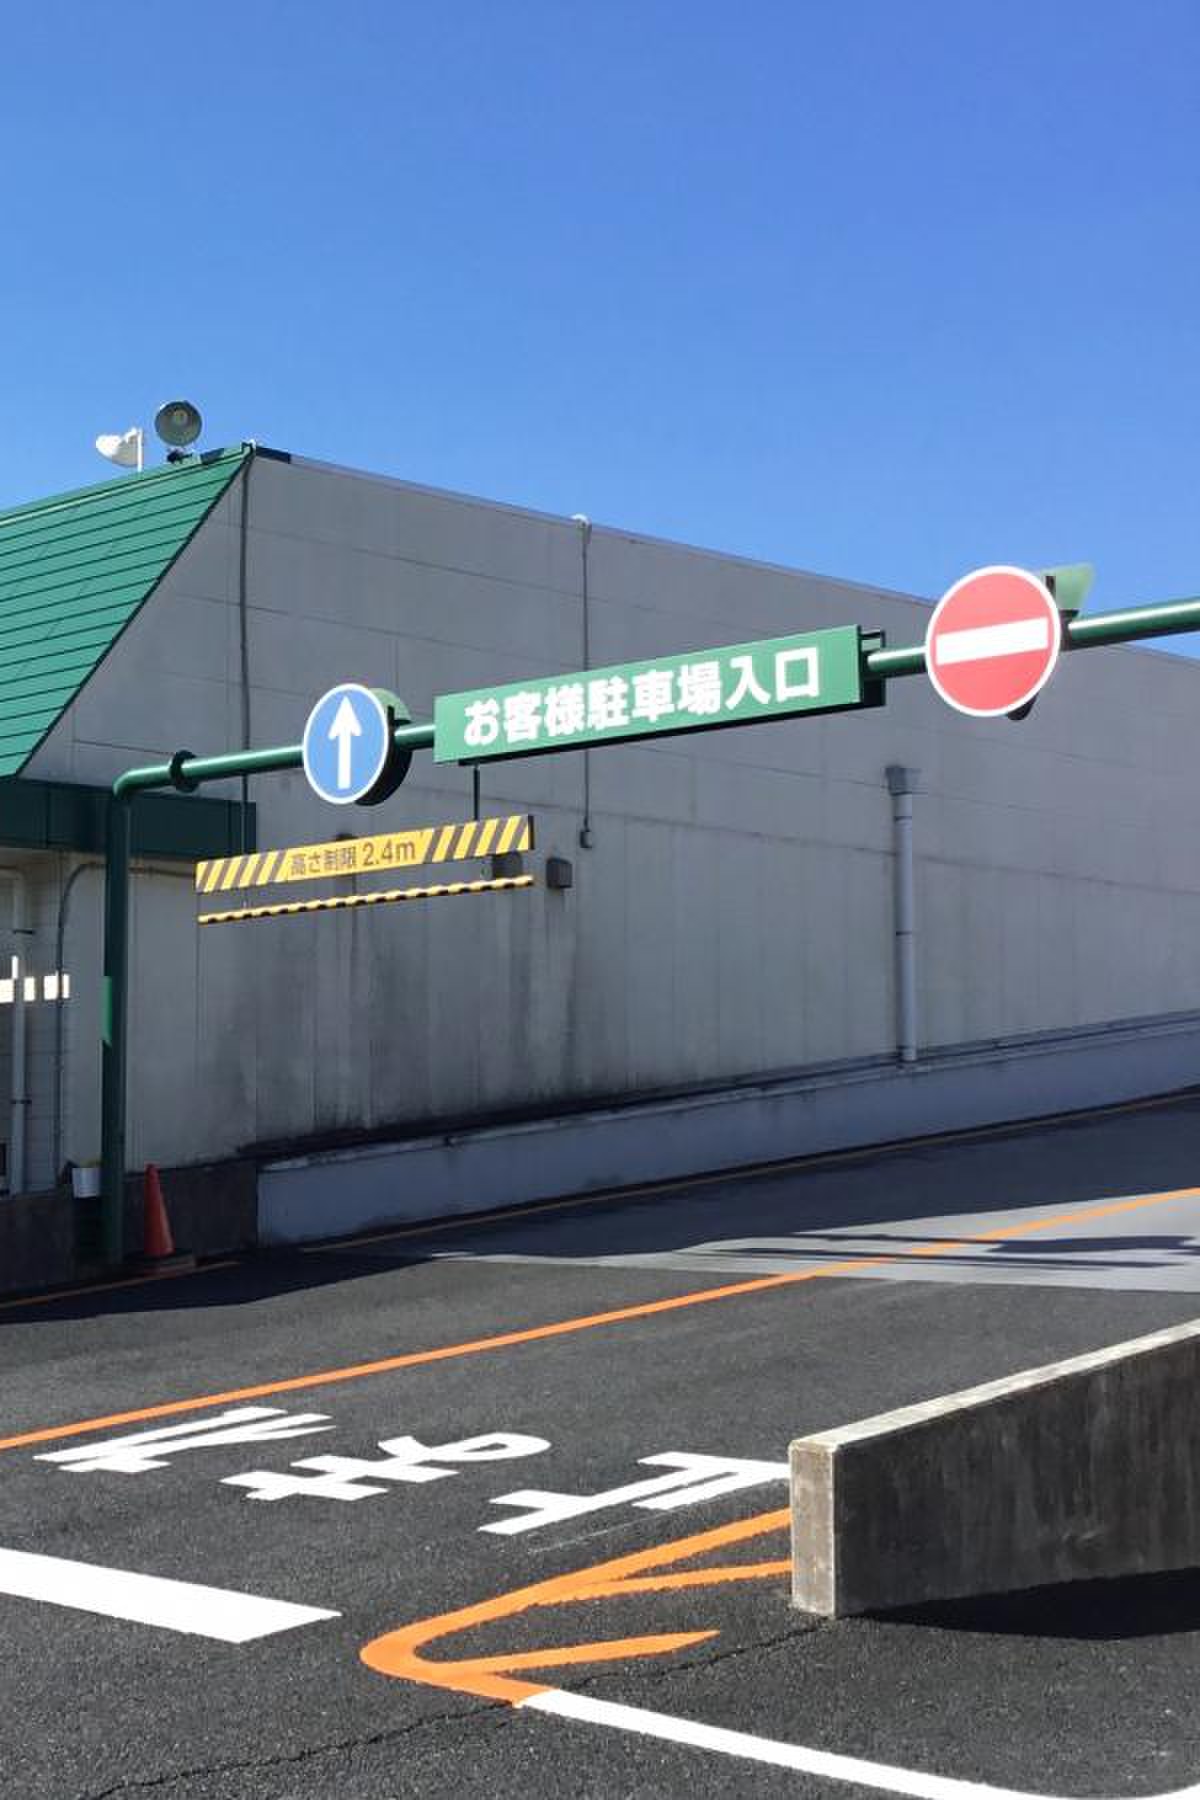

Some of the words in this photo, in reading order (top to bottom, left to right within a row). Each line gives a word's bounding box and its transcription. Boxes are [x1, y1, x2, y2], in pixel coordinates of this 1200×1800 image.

[463, 647, 820, 746] お客様駐車場入口
[362, 838, 416, 866] 2.4m
